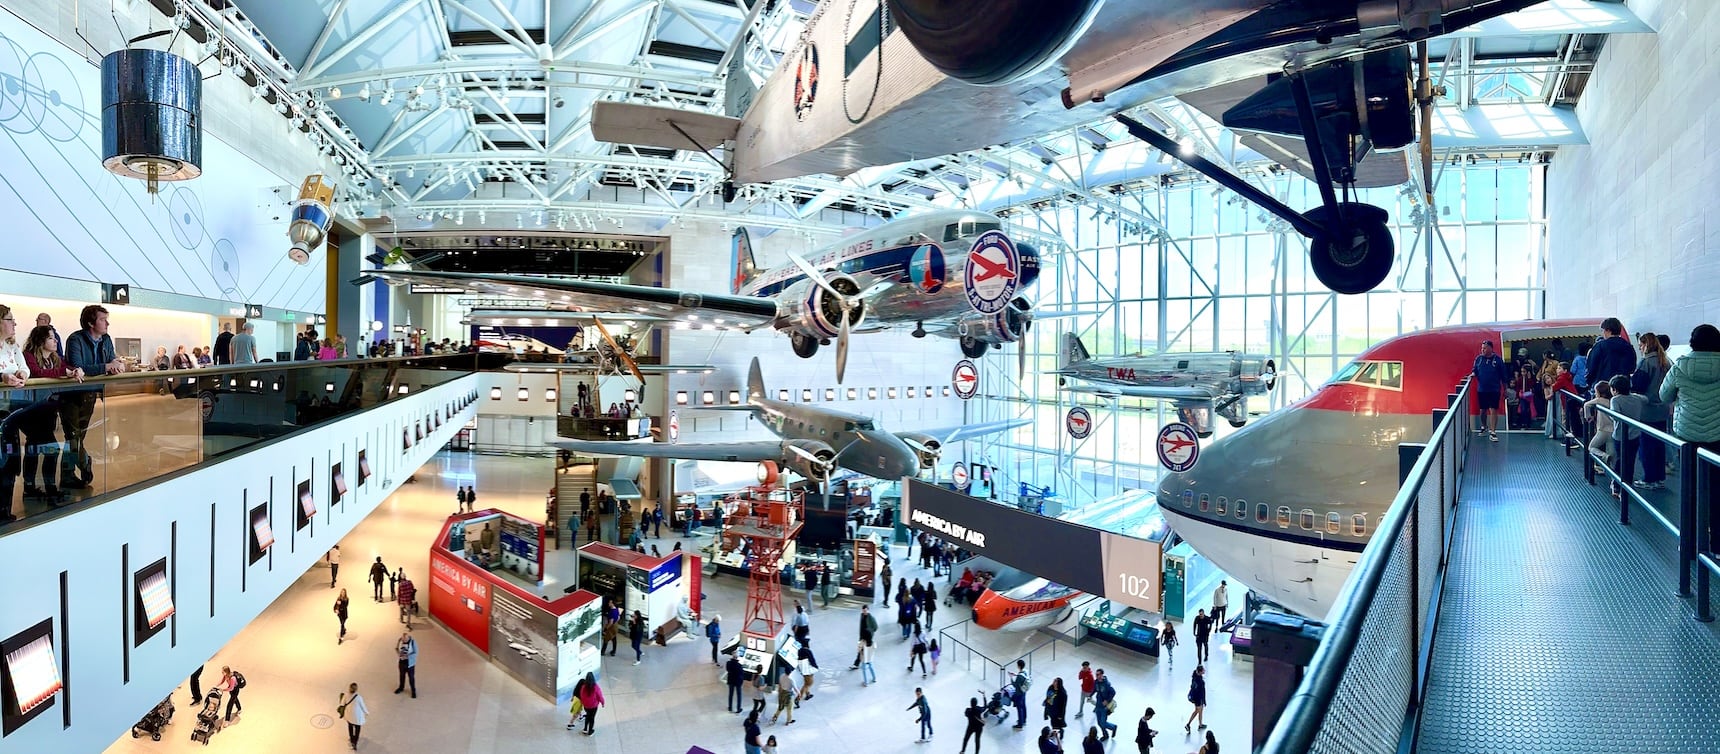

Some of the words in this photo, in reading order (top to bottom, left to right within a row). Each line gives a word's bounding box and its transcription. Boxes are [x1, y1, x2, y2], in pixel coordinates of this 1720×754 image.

[841, 239, 873, 259] LINES
[983, 235, 998, 246] FORD
[980, 285, 1014, 312] TRI-MOTOR
[1106, 367, 1136, 381] TWA
[911, 508, 952, 536] AMERICA
[952, 523, 967, 540] BY
[965, 529, 986, 548] AIR
[432, 557, 460, 584] AMERICA
[461, 574, 472, 589] BY
[473, 581, 487, 599] AIR
[1119, 573, 1150, 600] 102
[1001, 599, 1056, 618] AMERICAN
